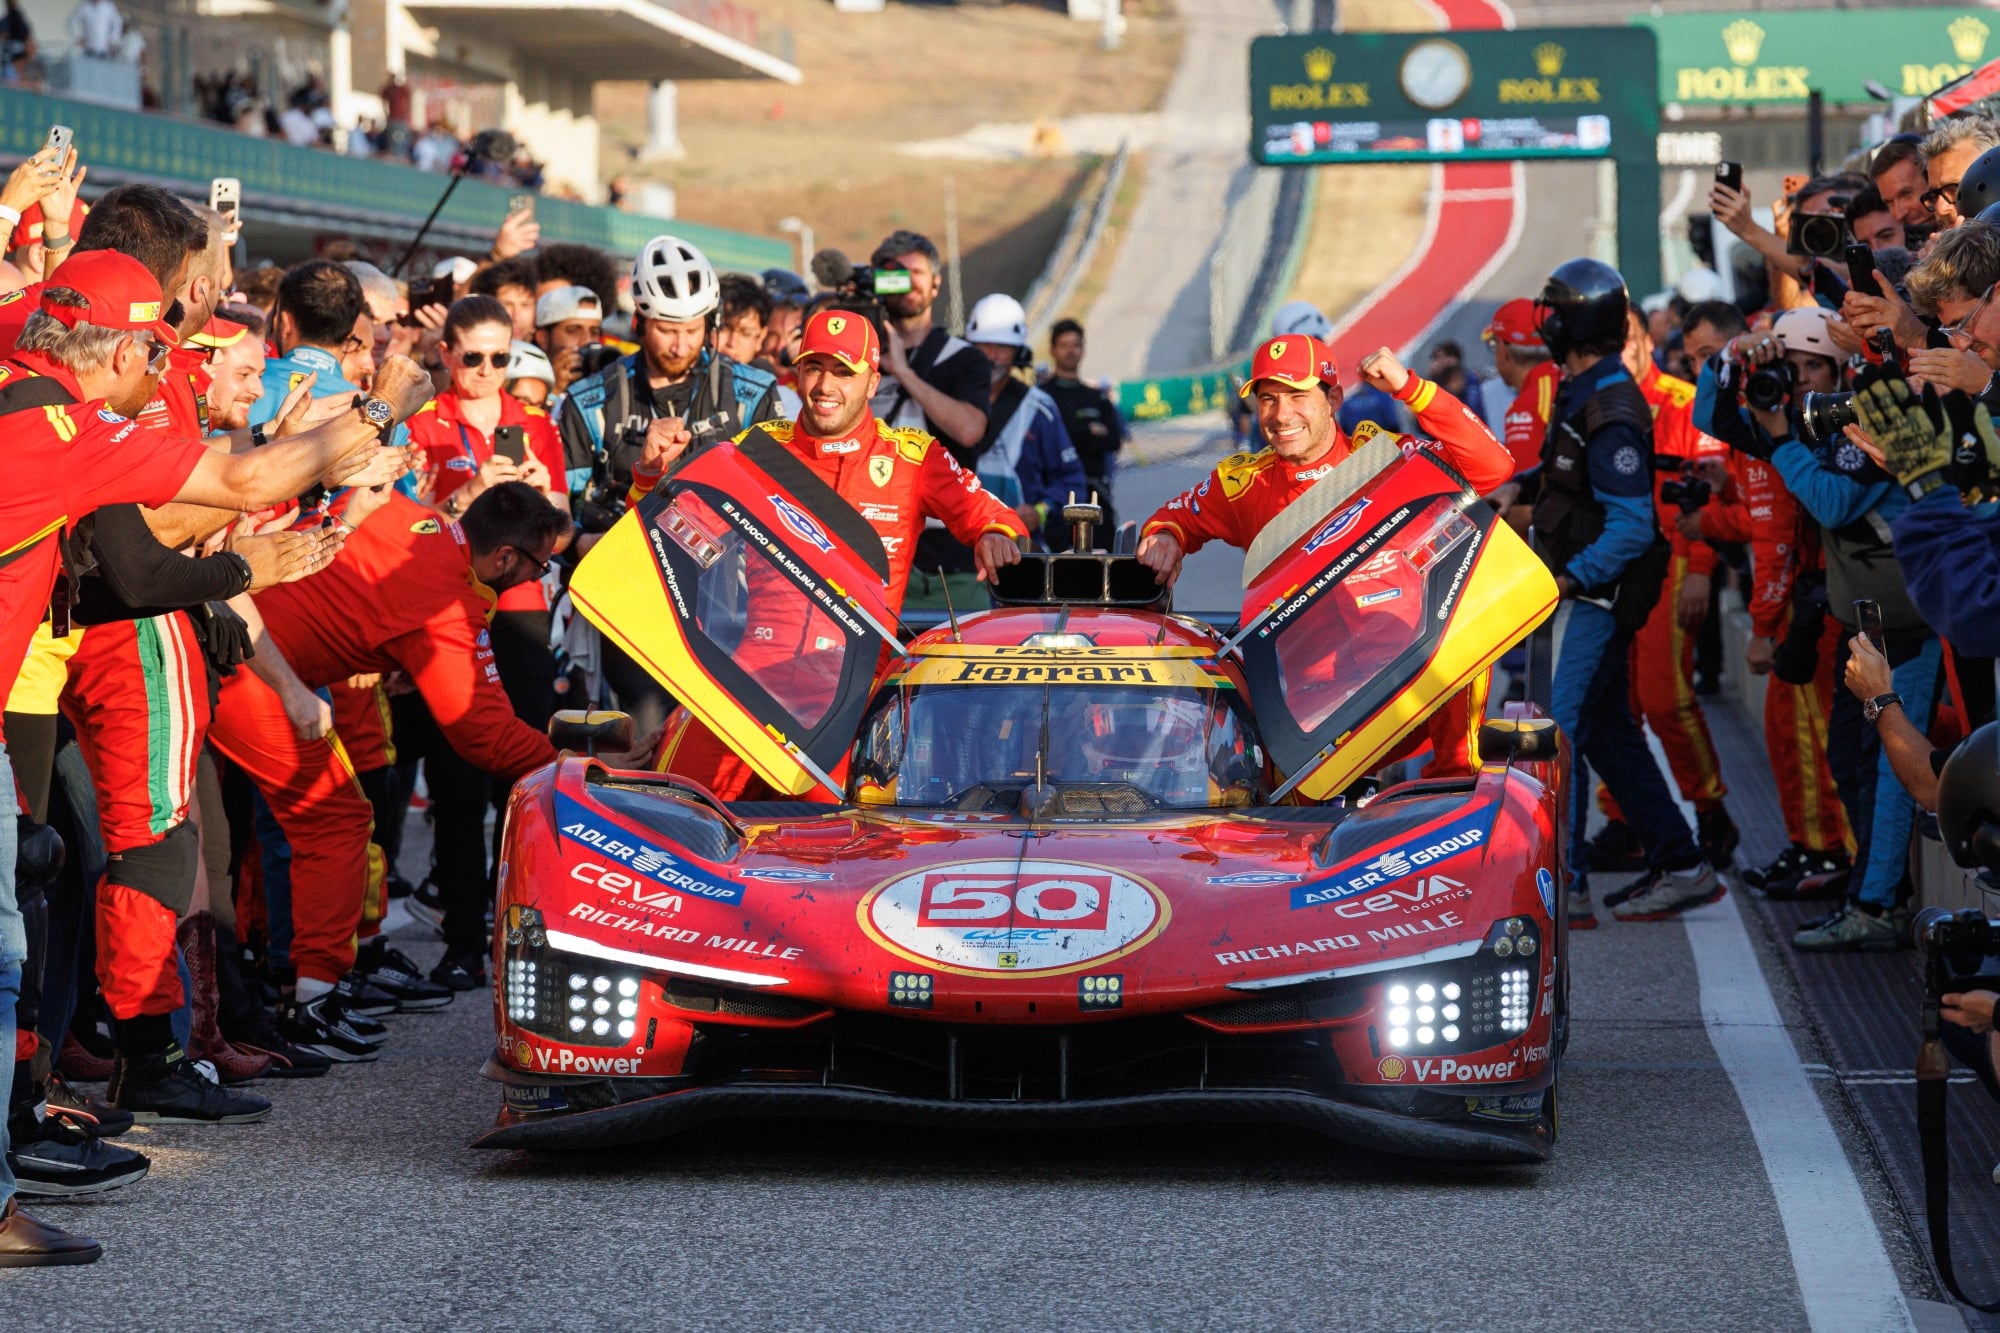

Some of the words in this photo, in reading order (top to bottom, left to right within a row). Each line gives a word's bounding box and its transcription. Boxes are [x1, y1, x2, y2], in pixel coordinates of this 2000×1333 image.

[1269, 82, 1370, 110] ROLEX
[1498, 78, 1602, 104] ROLEX
[1676, 67, 1809, 99] ROLEX
[1358, 424, 1378, 437] AT&
[649, 528, 689, 619] @FerrariHypercar
[730, 511, 741, 522] A.
[737, 517, 769, 546] FUOCO
[774, 552, 787, 564] M.
[783, 558, 816, 591] MOLINA
[823, 596, 833, 608] N.
[830, 602, 866, 637] NIELSEN
[1269, 619, 1281, 630] A.
[1277, 595, 1308, 622] FUOCO
[1315, 577, 1327, 589] M.
[1326, 552, 1359, 581] MOLINA
[1367, 535, 1377, 546] N.
[1374, 507, 1410, 537] NIELSEN
[1438, 530, 1483, 620] @FerrariHypercar
[754, 626, 773, 640] 50
[951, 661, 1157, 683] Ferrari
[562, 823, 635, 861] ADLER
[657, 868, 735, 899] GROUP
[1304, 872, 1385, 905] ADLER
[1413, 829, 1483, 865] GROUP
[610, 897, 676, 919] LOGISTICS
[927, 879, 1100, 921] 50
[1403, 888, 1473, 914] LOGISTICS
[568, 902, 700, 943] RICHARD
[704, 935, 804, 960] MILLE
[963, 929, 1057, 941] WEC
[1215, 934, 1361, 966] RICHARD
[1369, 911, 1463, 942] MILLE
[535, 1047, 642, 1074] V-Power
[1413, 1059, 1517, 1082] V-Power
